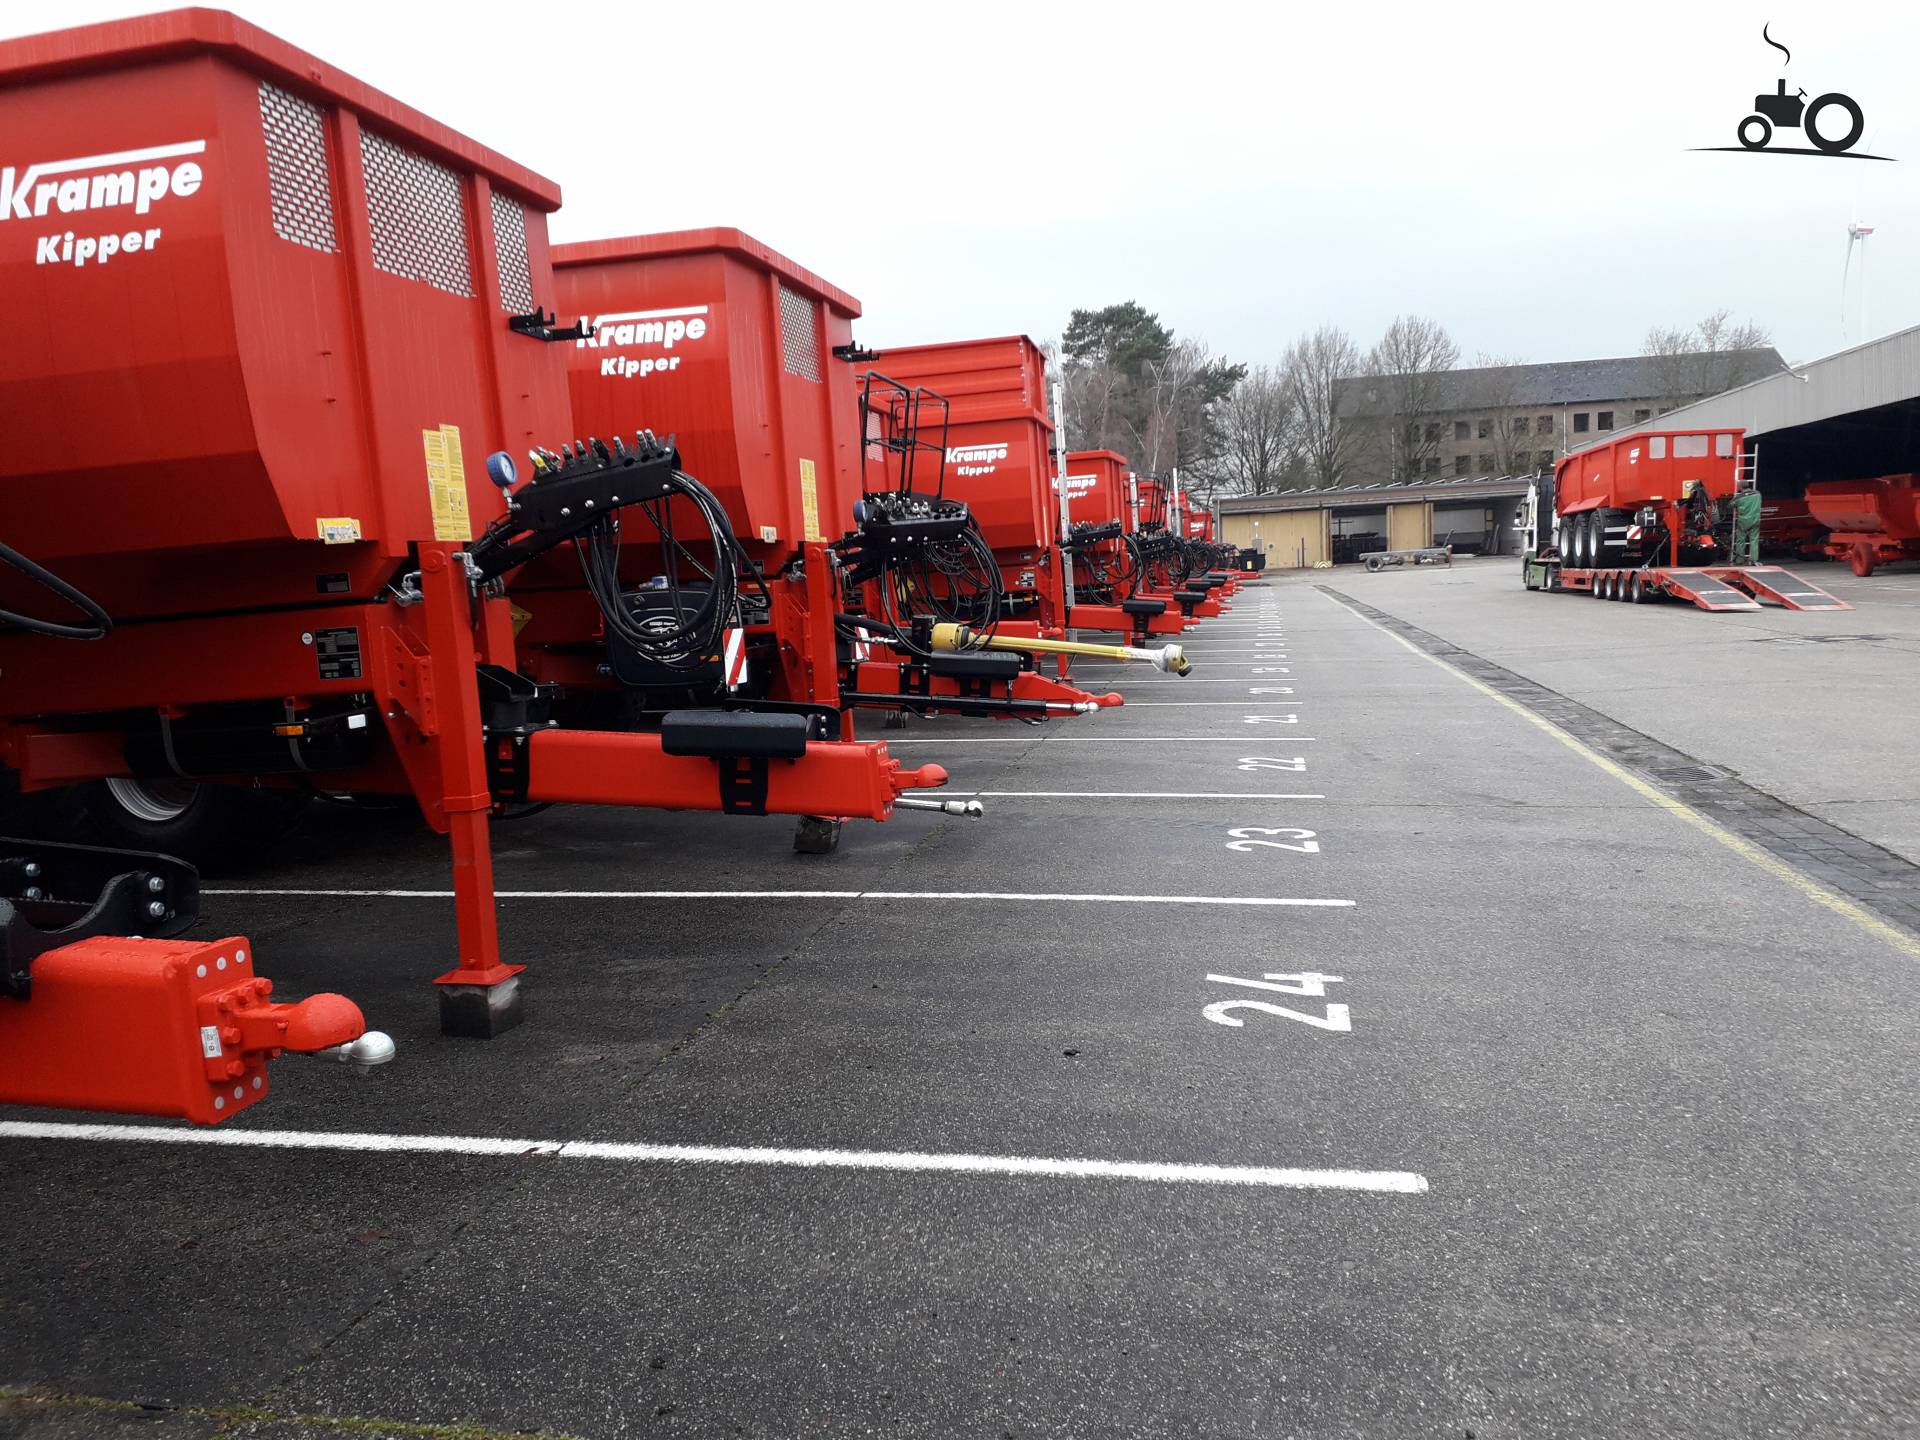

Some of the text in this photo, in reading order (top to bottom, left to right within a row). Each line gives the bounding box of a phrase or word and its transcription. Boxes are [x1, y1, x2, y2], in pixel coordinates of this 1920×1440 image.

[0, 140, 206, 220] Krampe
[36, 228, 161, 267] Kipper
[576, 305, 708, 348] Krampe
[600, 356, 680, 378] Kipper
[946, 443, 1008, 463] Krampe
[957, 465, 995, 476] Kipper
[1052, 474, 1097, 489] Kampe
[1237, 757, 1306, 771] 22
[1226, 828, 1320, 852] 23
[1203, 972, 1352, 1031] 24
